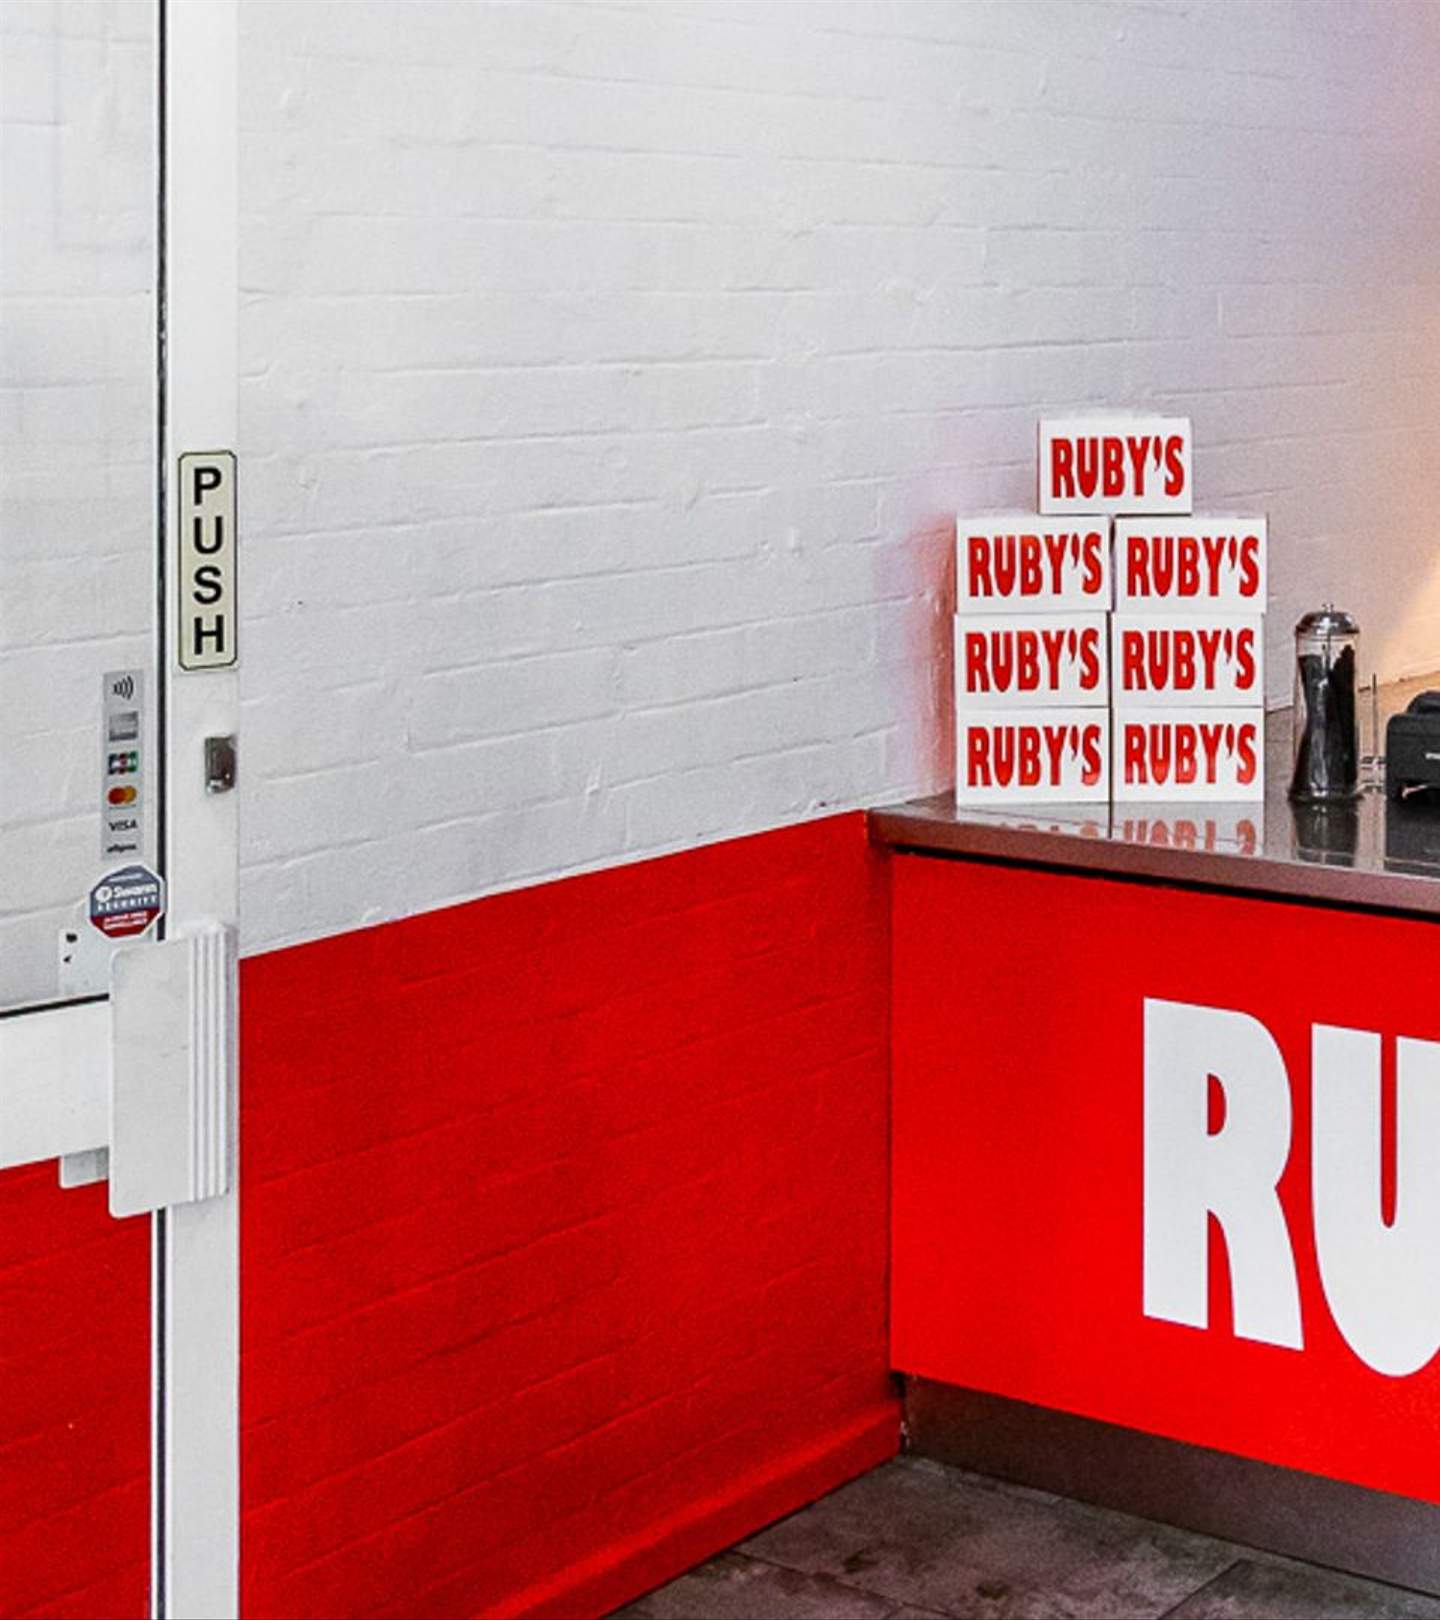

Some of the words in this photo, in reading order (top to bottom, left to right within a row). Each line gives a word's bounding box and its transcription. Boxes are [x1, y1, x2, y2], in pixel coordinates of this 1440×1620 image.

[1051, 436, 1184, 498] RUBY'S
[193, 467, 224, 656] PUSH
[968, 533, 1102, 596] RUBY'S
[1127, 536, 1259, 597] RUBY'S
[966, 628, 1099, 691] RUBY'S
[1123, 629, 1255, 690] RUBY'S
[967, 725, 1101, 787] RUBY'S
[1125, 724, 1256, 784] RUBY'S
[108, 818, 139, 832] VISA
